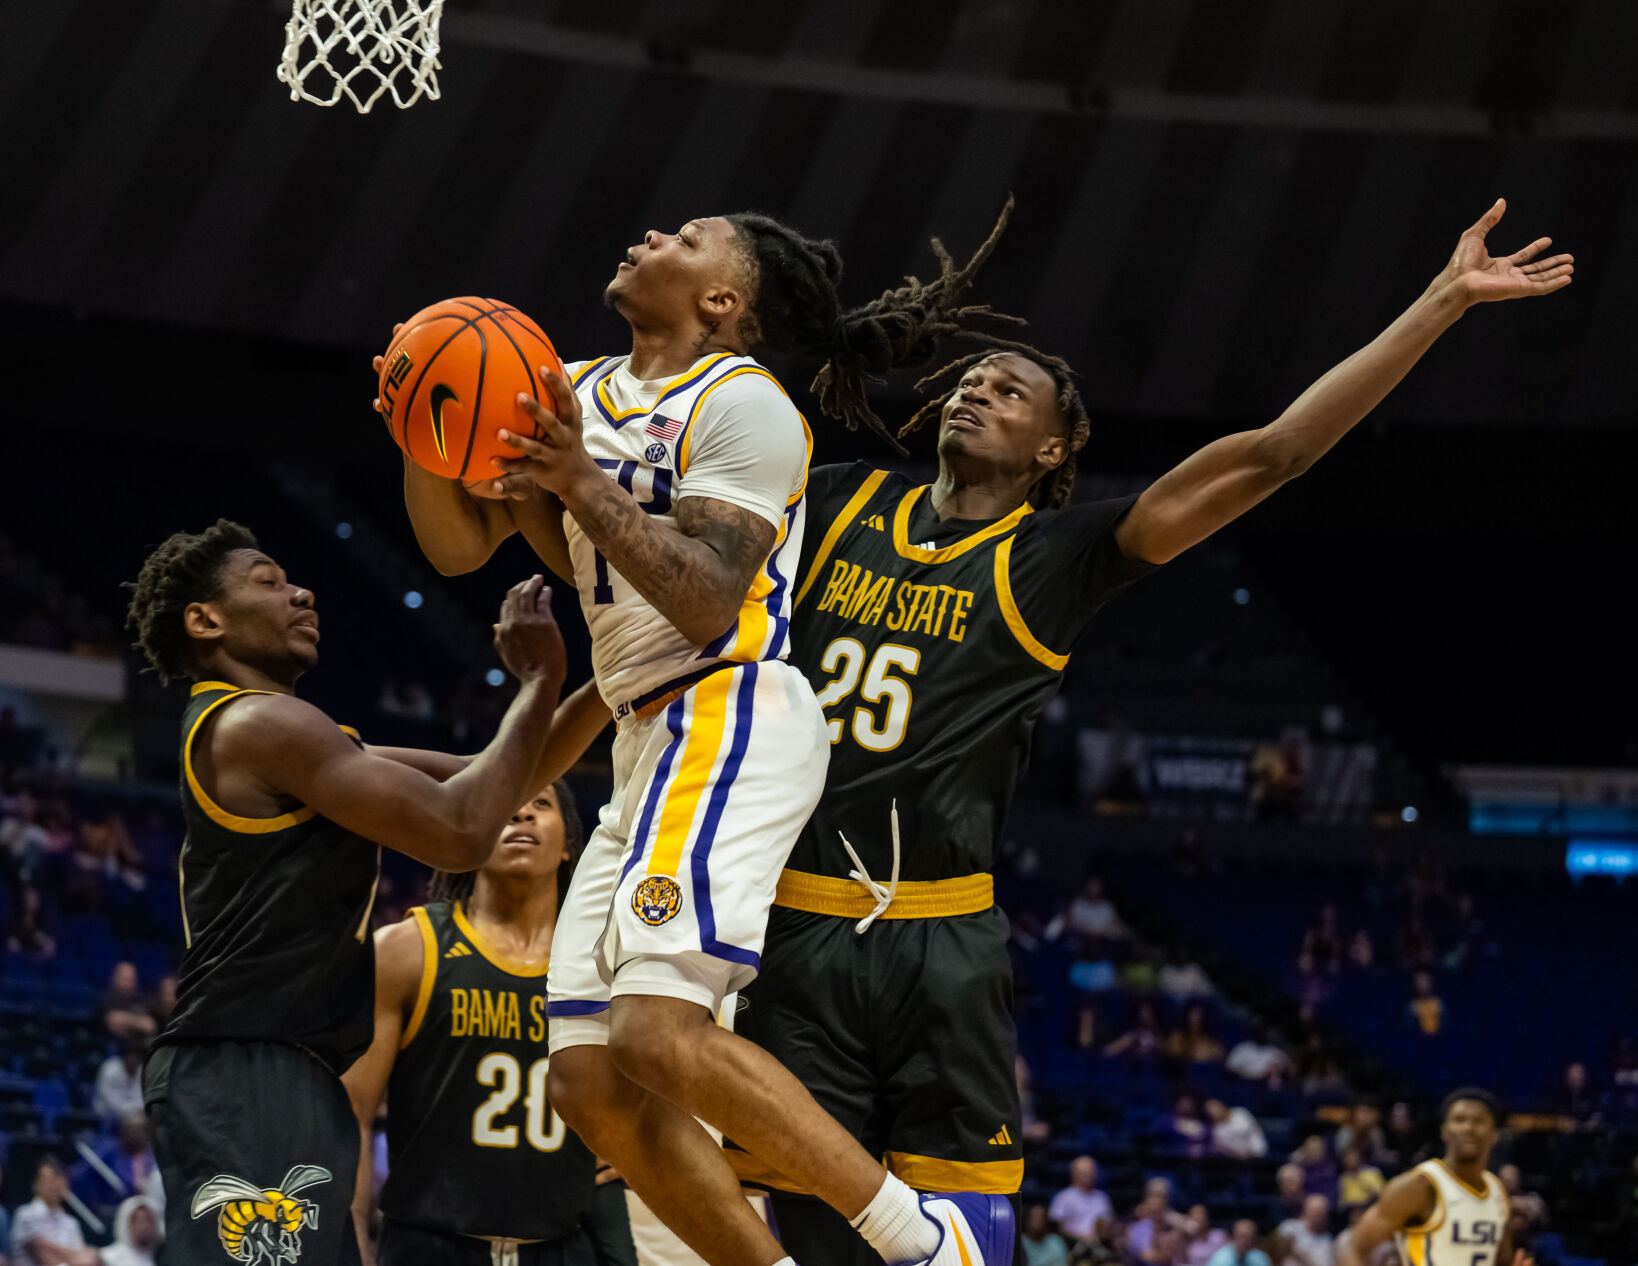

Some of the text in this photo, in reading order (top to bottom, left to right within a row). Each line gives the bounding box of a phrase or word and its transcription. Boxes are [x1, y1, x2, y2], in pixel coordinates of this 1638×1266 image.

[646, 443, 666, 462] SEC
[816, 559, 974, 643] BAMA STATE
[815, 637, 921, 753] 25
[451, 988, 547, 1042] BAMA S
[472, 1052, 566, 1152] 20
